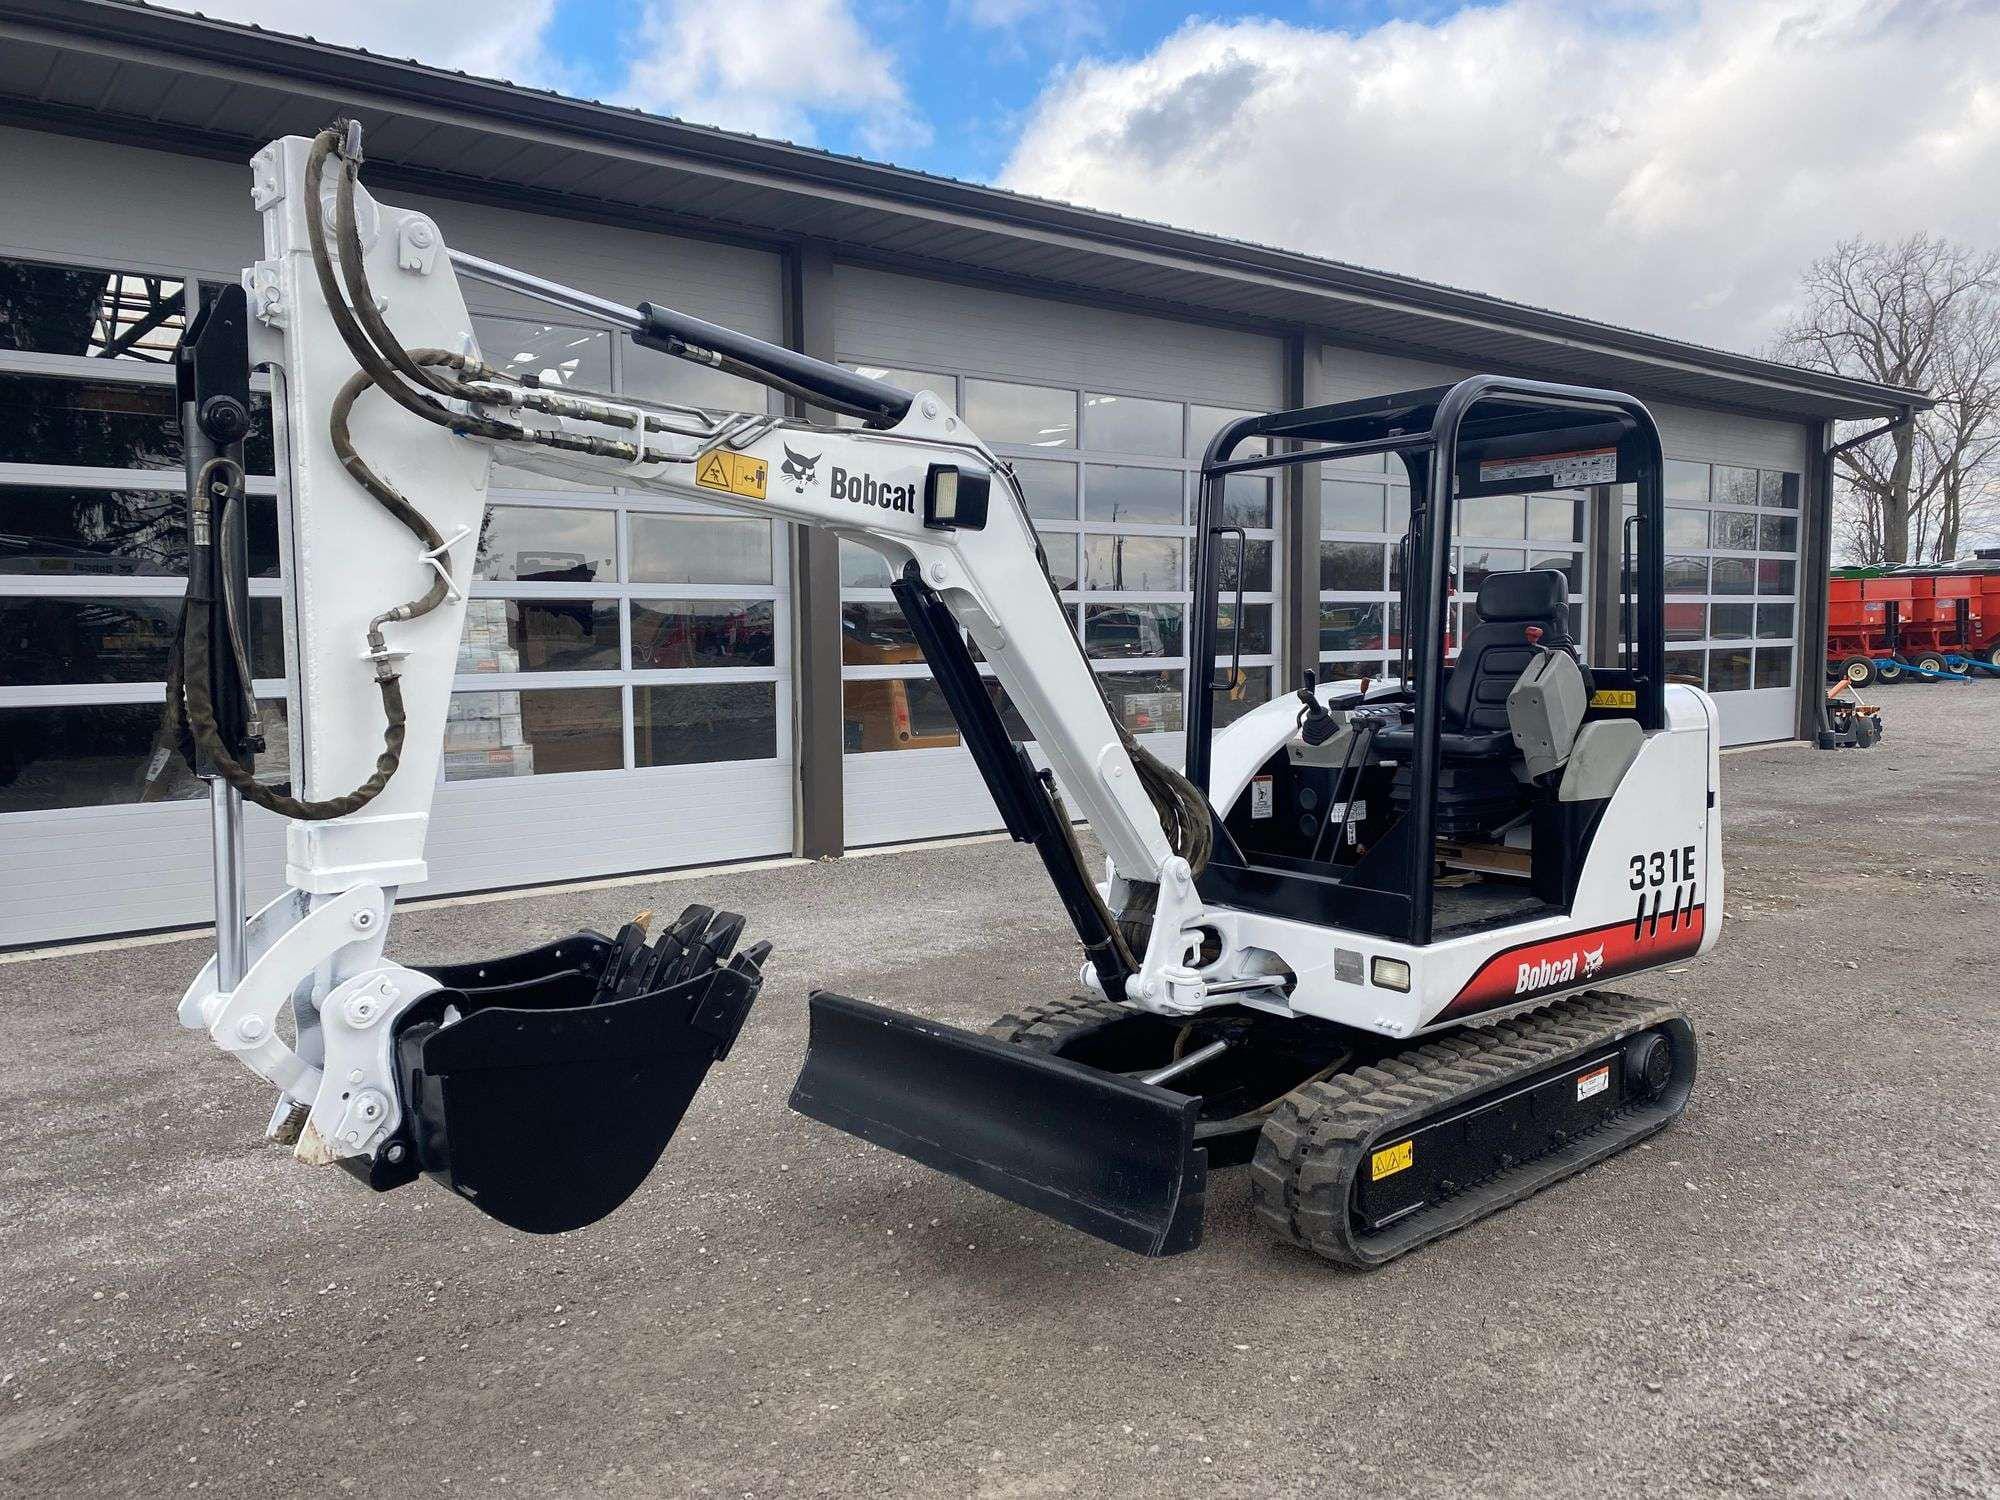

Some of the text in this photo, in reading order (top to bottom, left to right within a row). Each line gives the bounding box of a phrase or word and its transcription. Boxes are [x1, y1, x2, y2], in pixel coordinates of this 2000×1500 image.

[831, 467, 916, 514] Bobcat
[1629, 845, 1696, 891] 331E
[1515, 954, 1578, 994] Bobcat
